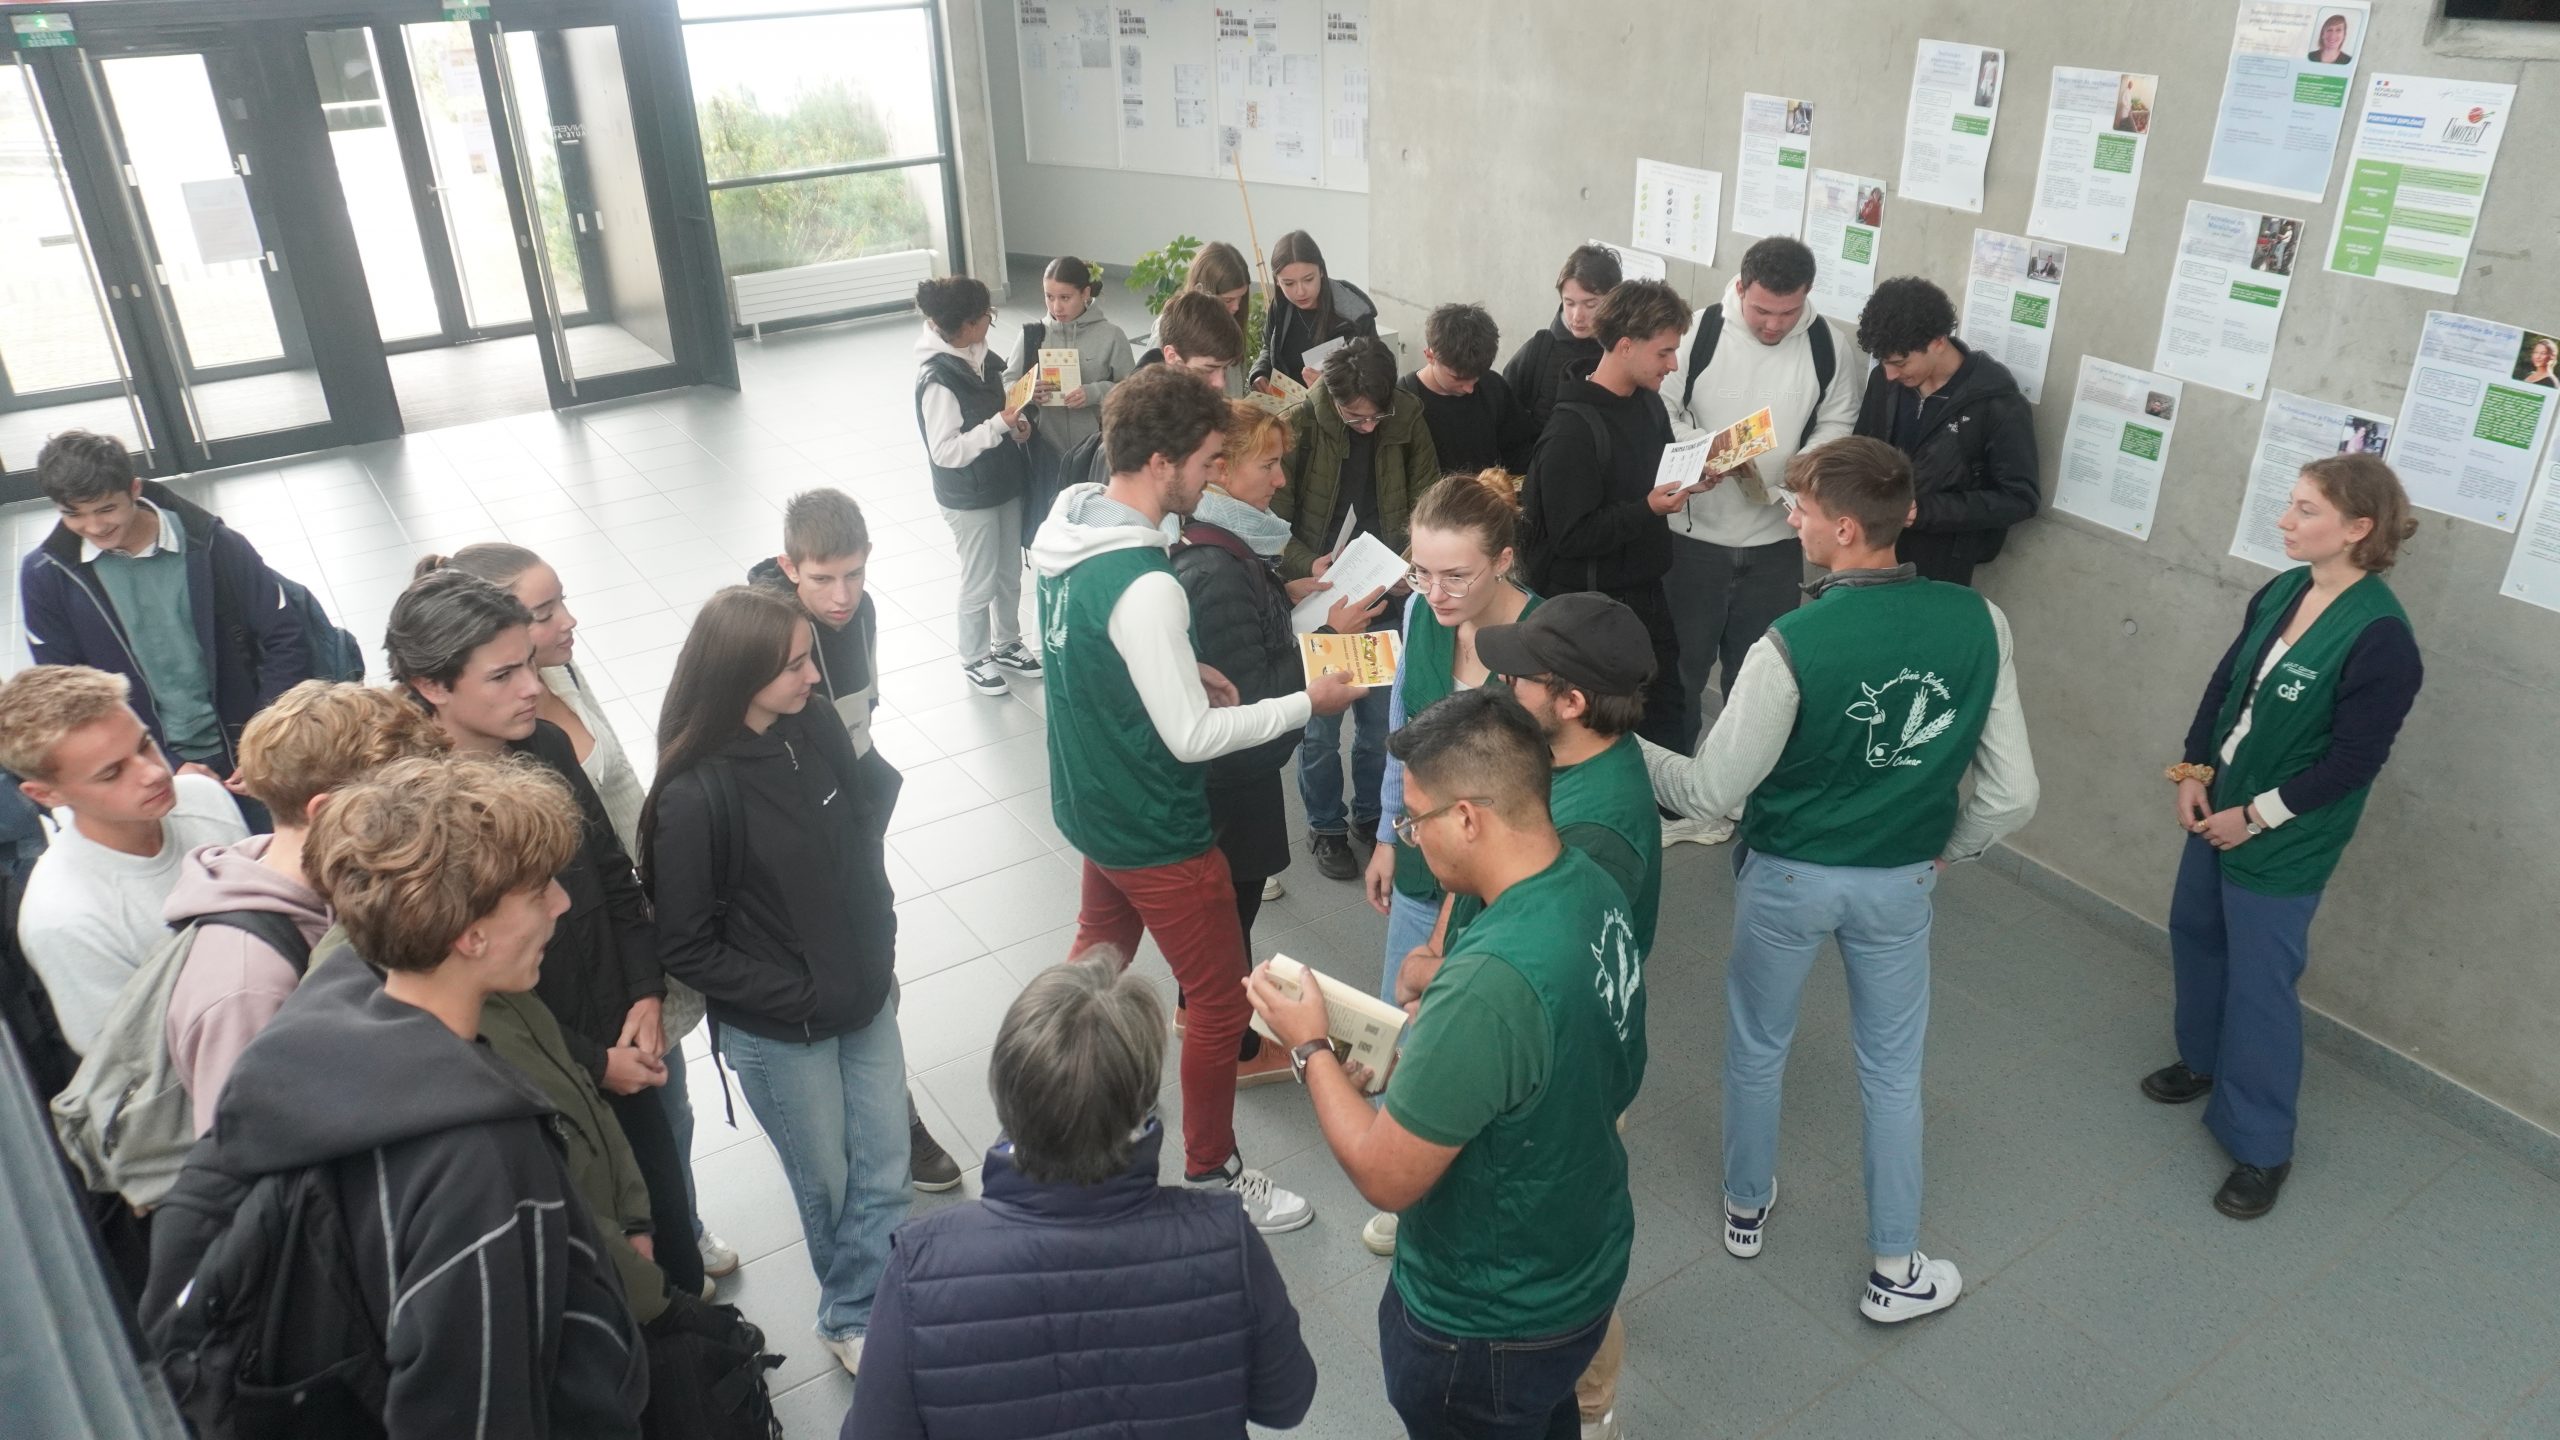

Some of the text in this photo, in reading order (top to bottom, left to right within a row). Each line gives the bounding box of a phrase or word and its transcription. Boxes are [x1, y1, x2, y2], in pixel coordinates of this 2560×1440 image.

[1899, 667, 1951, 700] Génie Biologique
[2277, 683, 2299, 701] GB
[1892, 756, 1922, 767] Colmar
[1728, 1229, 1759, 1245] NIKE
